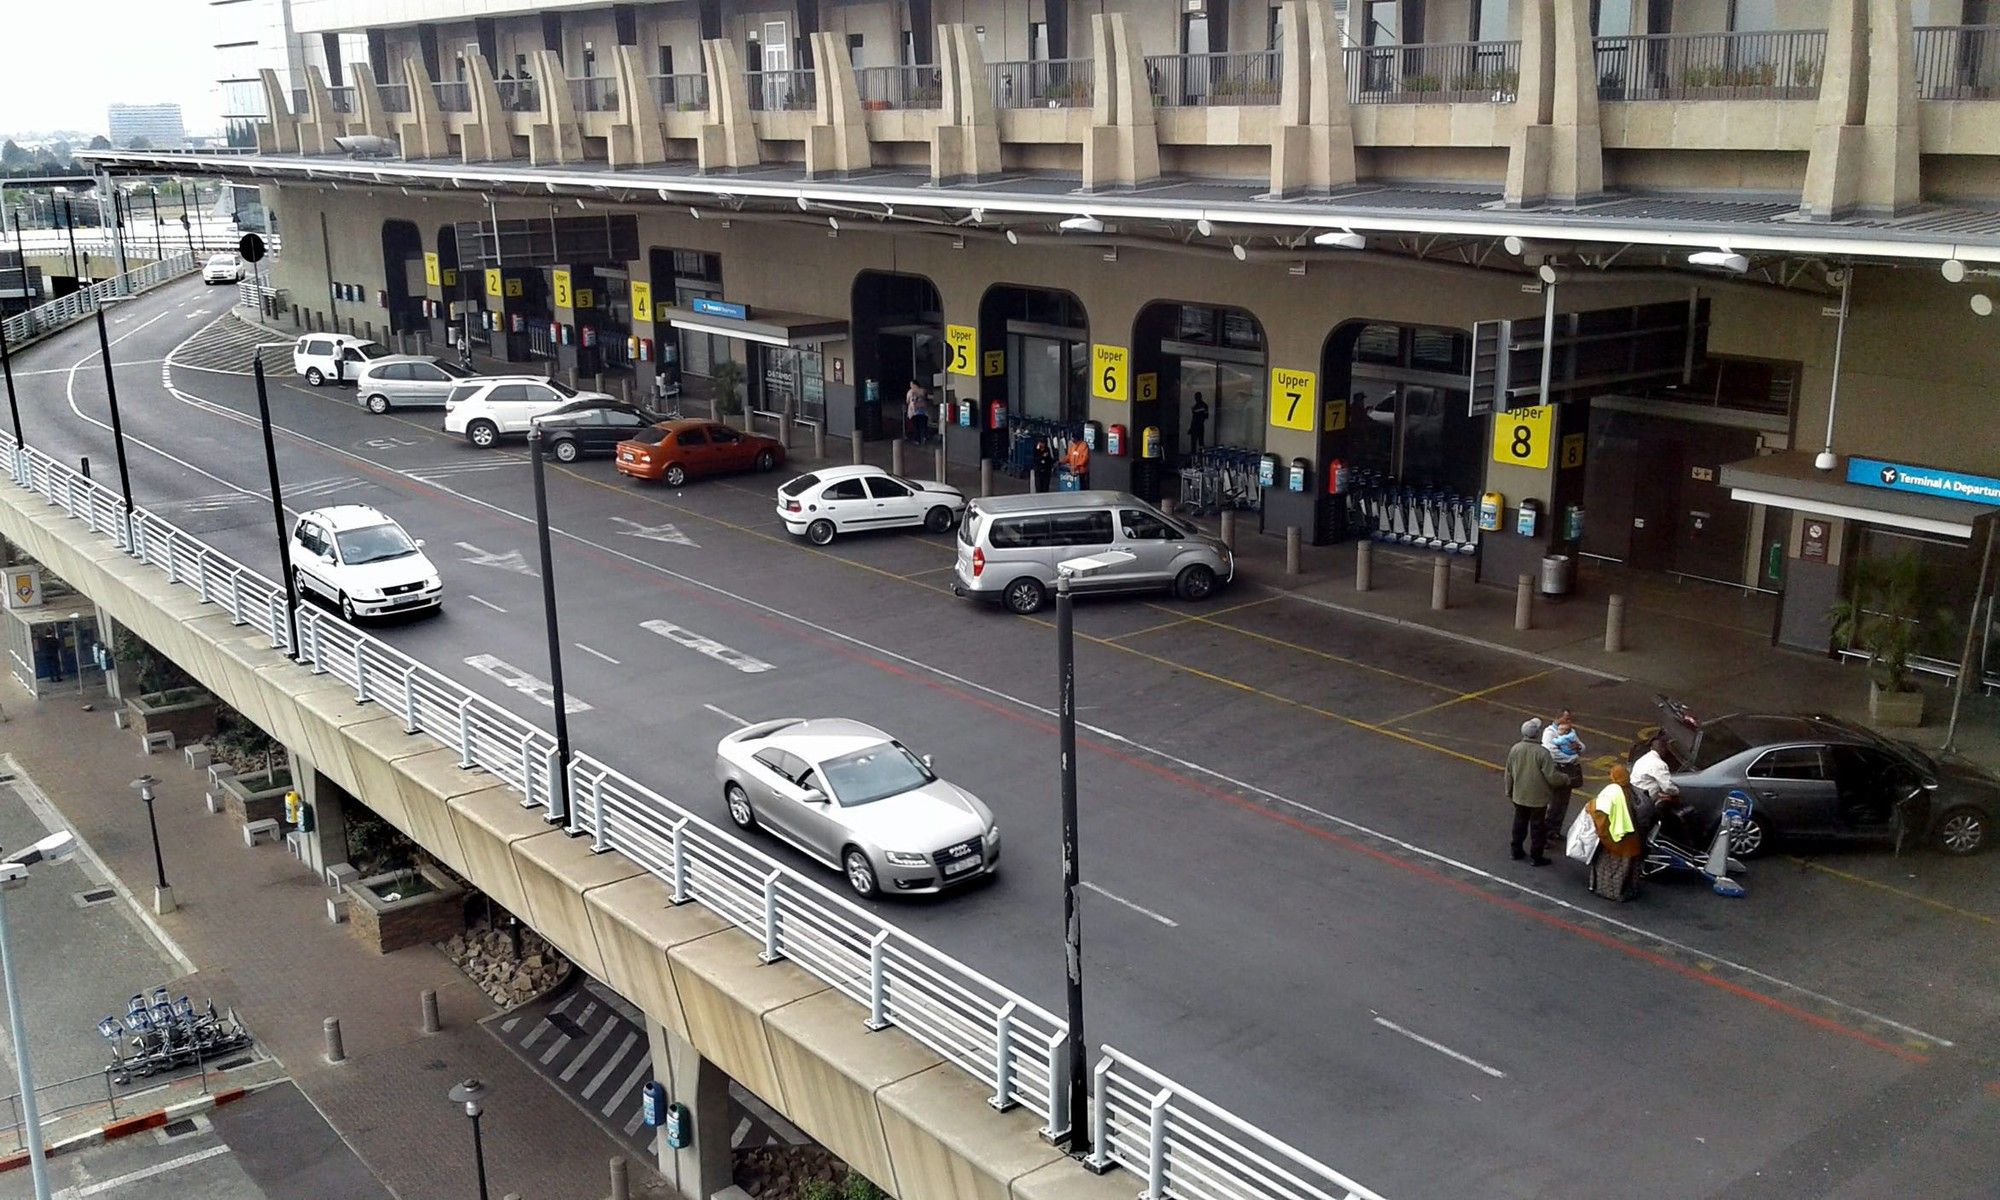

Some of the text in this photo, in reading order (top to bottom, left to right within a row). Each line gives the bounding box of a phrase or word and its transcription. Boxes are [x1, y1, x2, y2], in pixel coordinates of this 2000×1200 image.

[430, 265, 436, 281] 1
[490, 274, 497, 291] 2
[511, 284, 518, 294] 2
[559, 284, 566, 303] 3
[581, 295, 589, 306] 3
[638, 297, 646, 316] 4
[951, 329, 972, 341] Upper
[957, 345, 967, 369] 5
[1097, 348, 1123, 363] Upper
[991, 360, 998, 373] 5
[1103, 366, 1116, 393] 6
[1278, 372, 1309, 389] Upper
[1143, 384, 1151, 398] 6
[1286, 392, 1301, 421] 7
[1332, 411, 1339, 427] 7
[1511, 425, 1531, 458] 8
[1569, 447, 1576, 464] 8
[1900, 473, 2000, 497] Terminal A Departur
